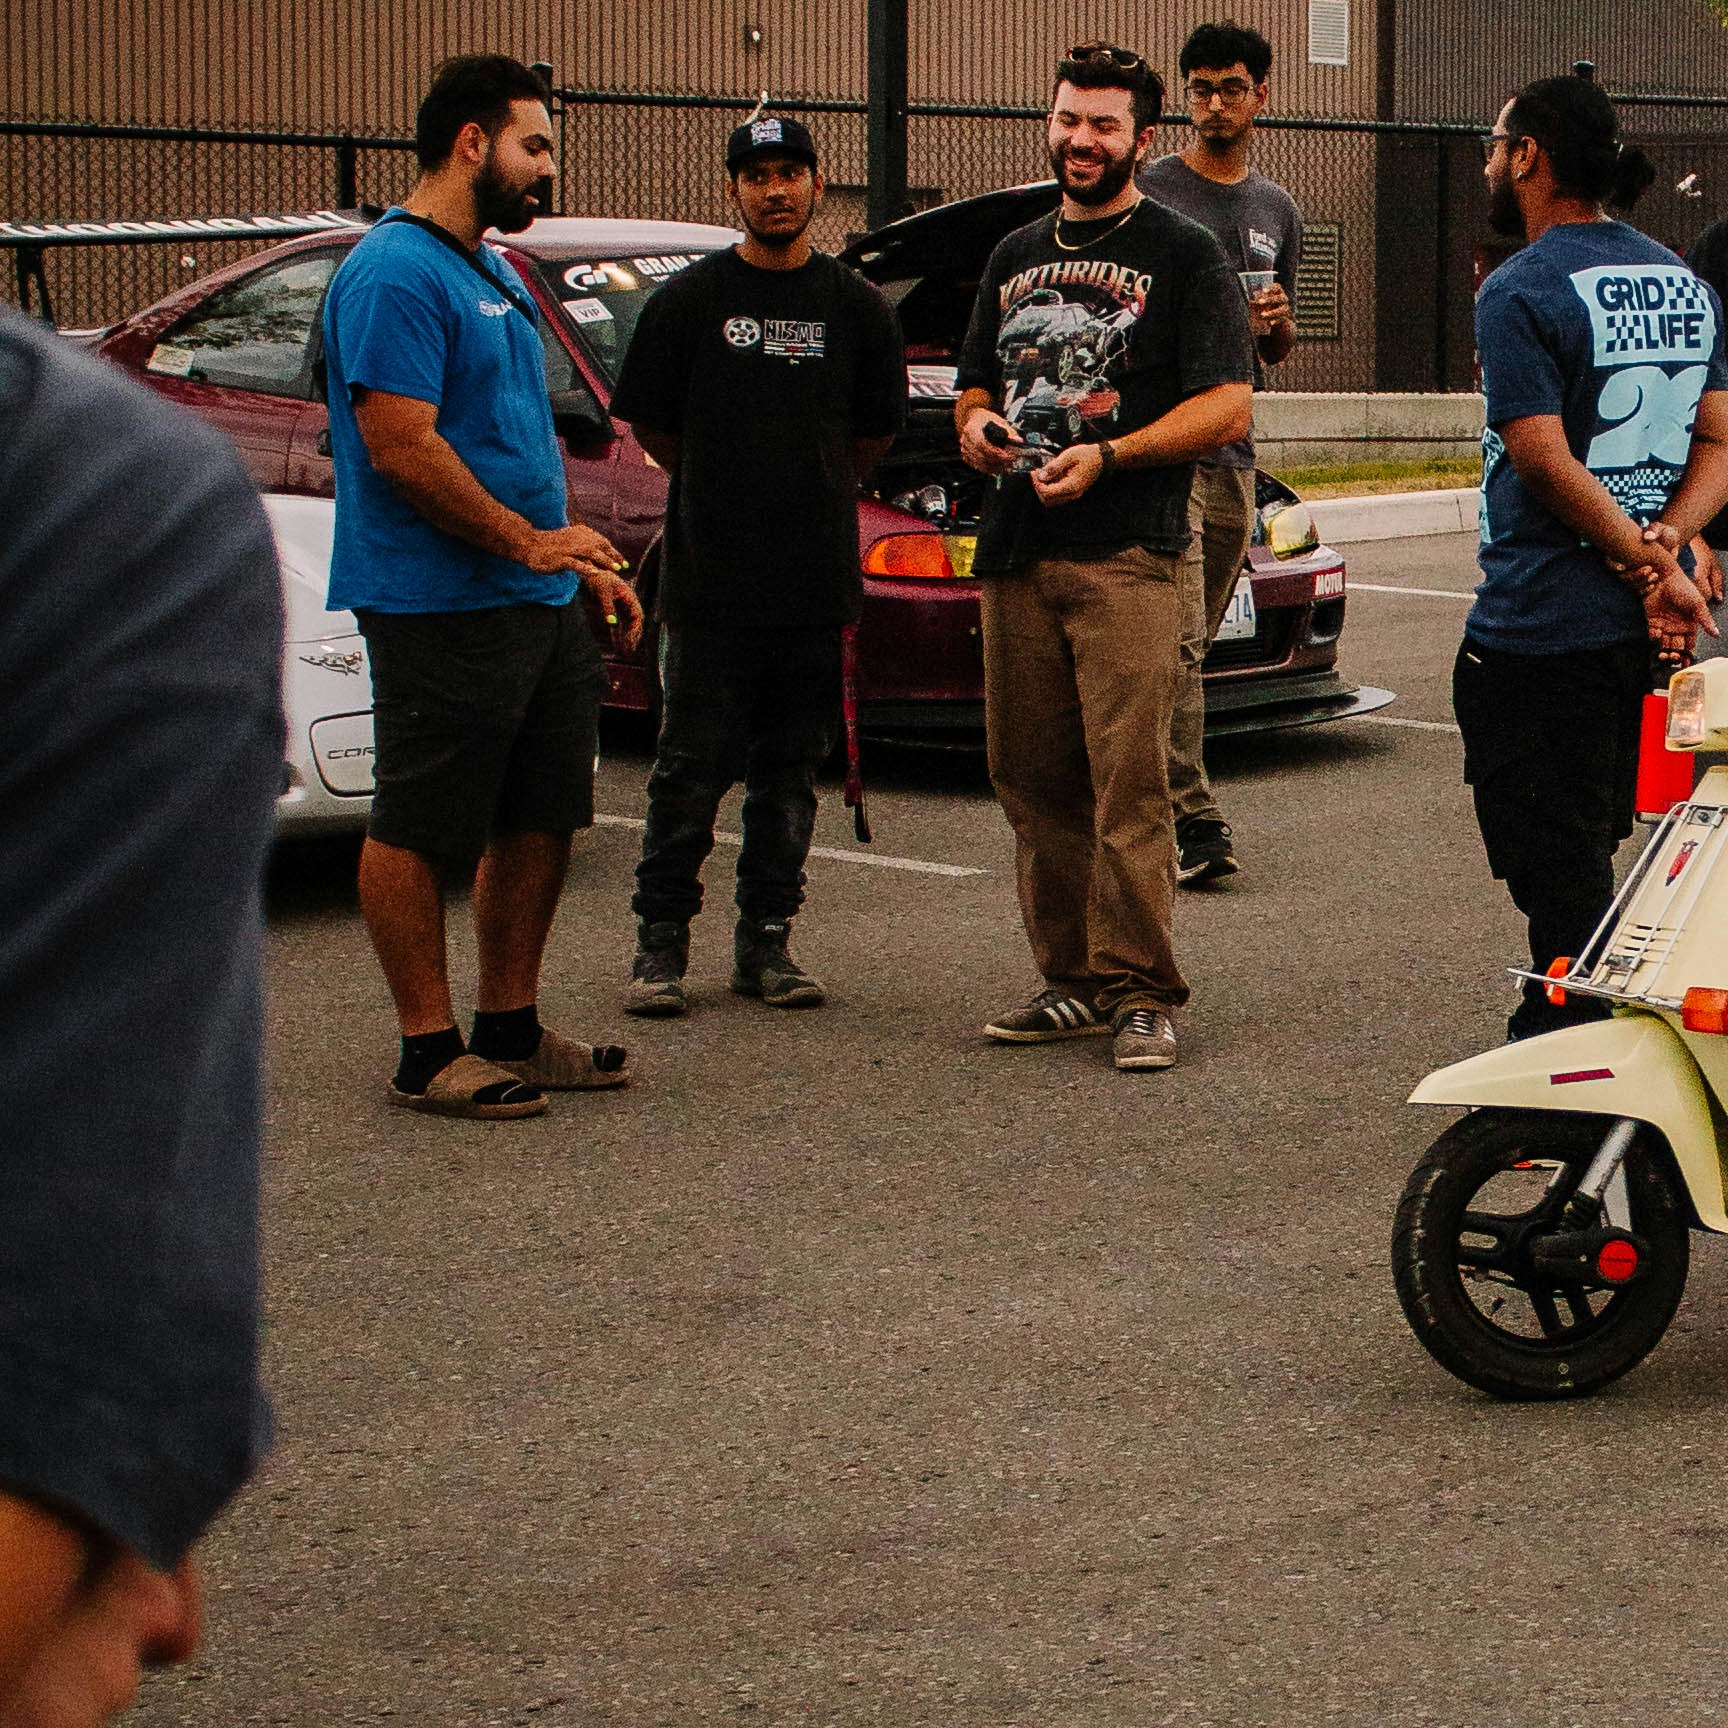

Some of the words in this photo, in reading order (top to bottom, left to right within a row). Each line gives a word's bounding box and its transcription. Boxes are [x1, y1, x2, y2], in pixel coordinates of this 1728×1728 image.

[1595, 276, 1666, 312] GRID
[579, 307, 601, 318] VIP
[763, 319, 826, 343] NISMO
[1642, 313, 1706, 350] LIFE
[1314, 571, 1344, 596] MOTU
